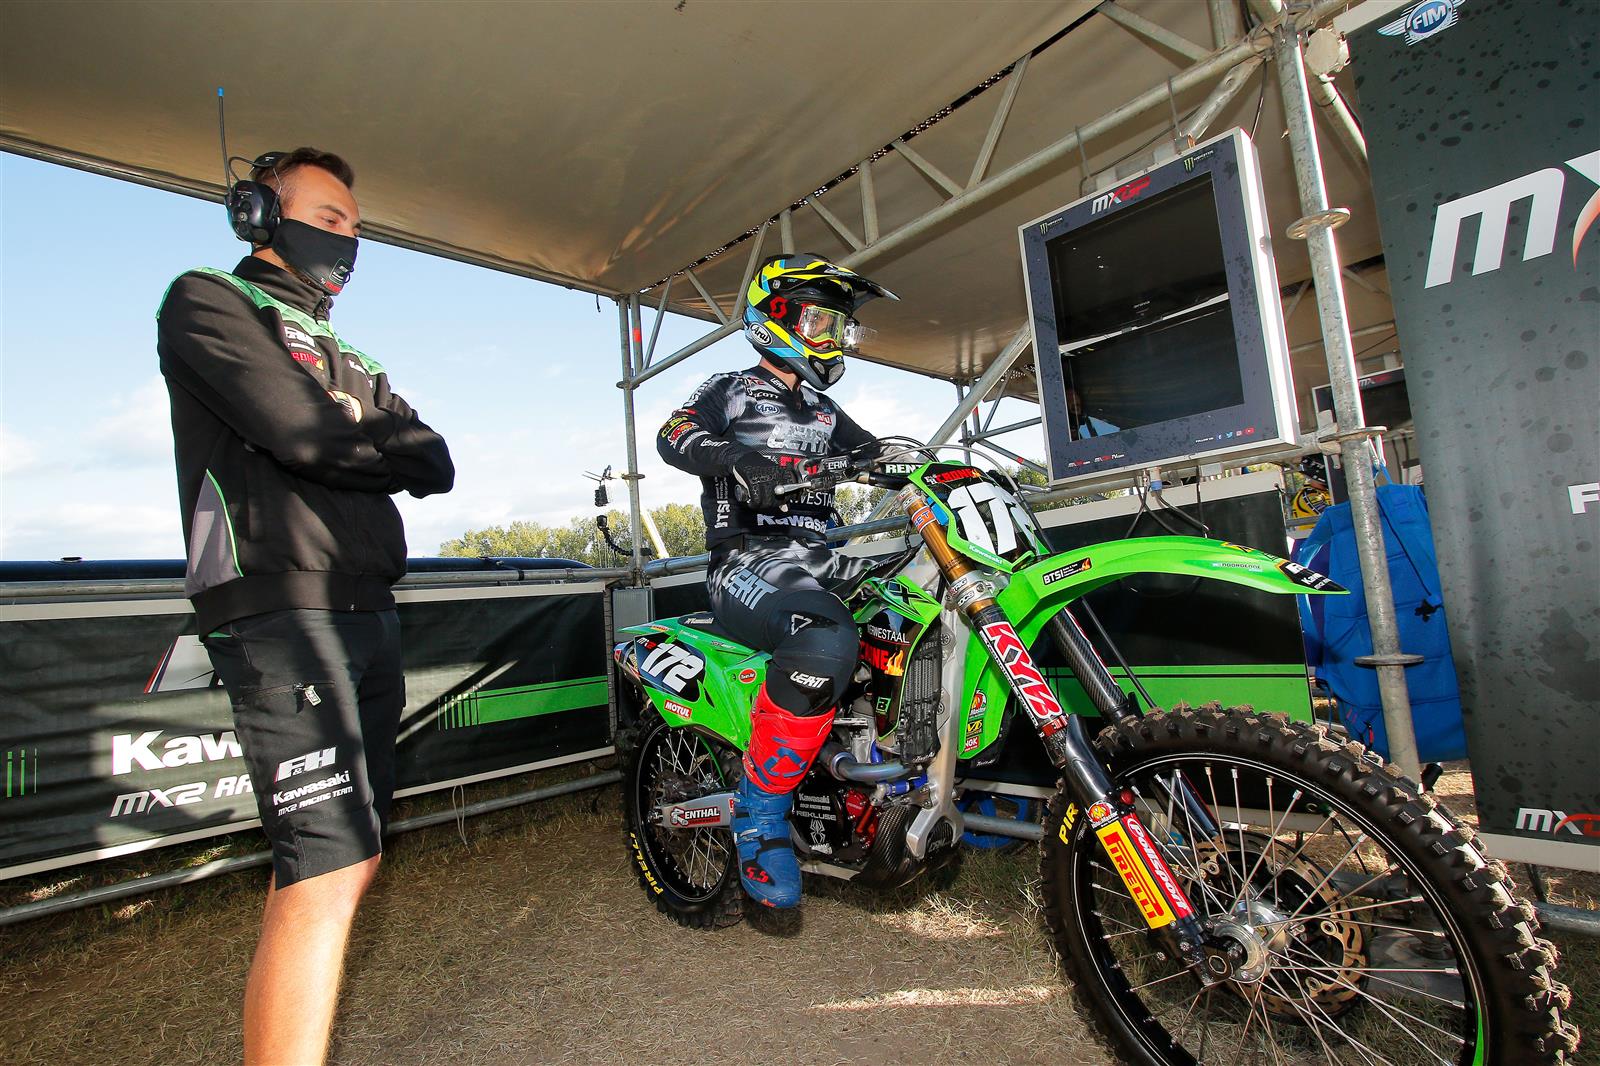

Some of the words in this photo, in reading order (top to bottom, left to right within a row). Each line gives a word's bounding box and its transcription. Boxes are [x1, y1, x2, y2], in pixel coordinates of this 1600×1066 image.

[1411, 4, 1448, 30] FIM
[751, 326, 769, 344] Arai
[641, 642, 704, 693] 172
[789, 671, 831, 689] LEATT
[983, 622, 1062, 719] KYB
[665, 701, 690, 717] MOTUL
[112, 730, 244, 776] Kaw
[273, 770, 350, 806] Kawasaki
[332, 785, 353, 798] TEAM
[1103, 831, 1164, 919] PIRELLI
[1127, 817, 1189, 913] Polisport
